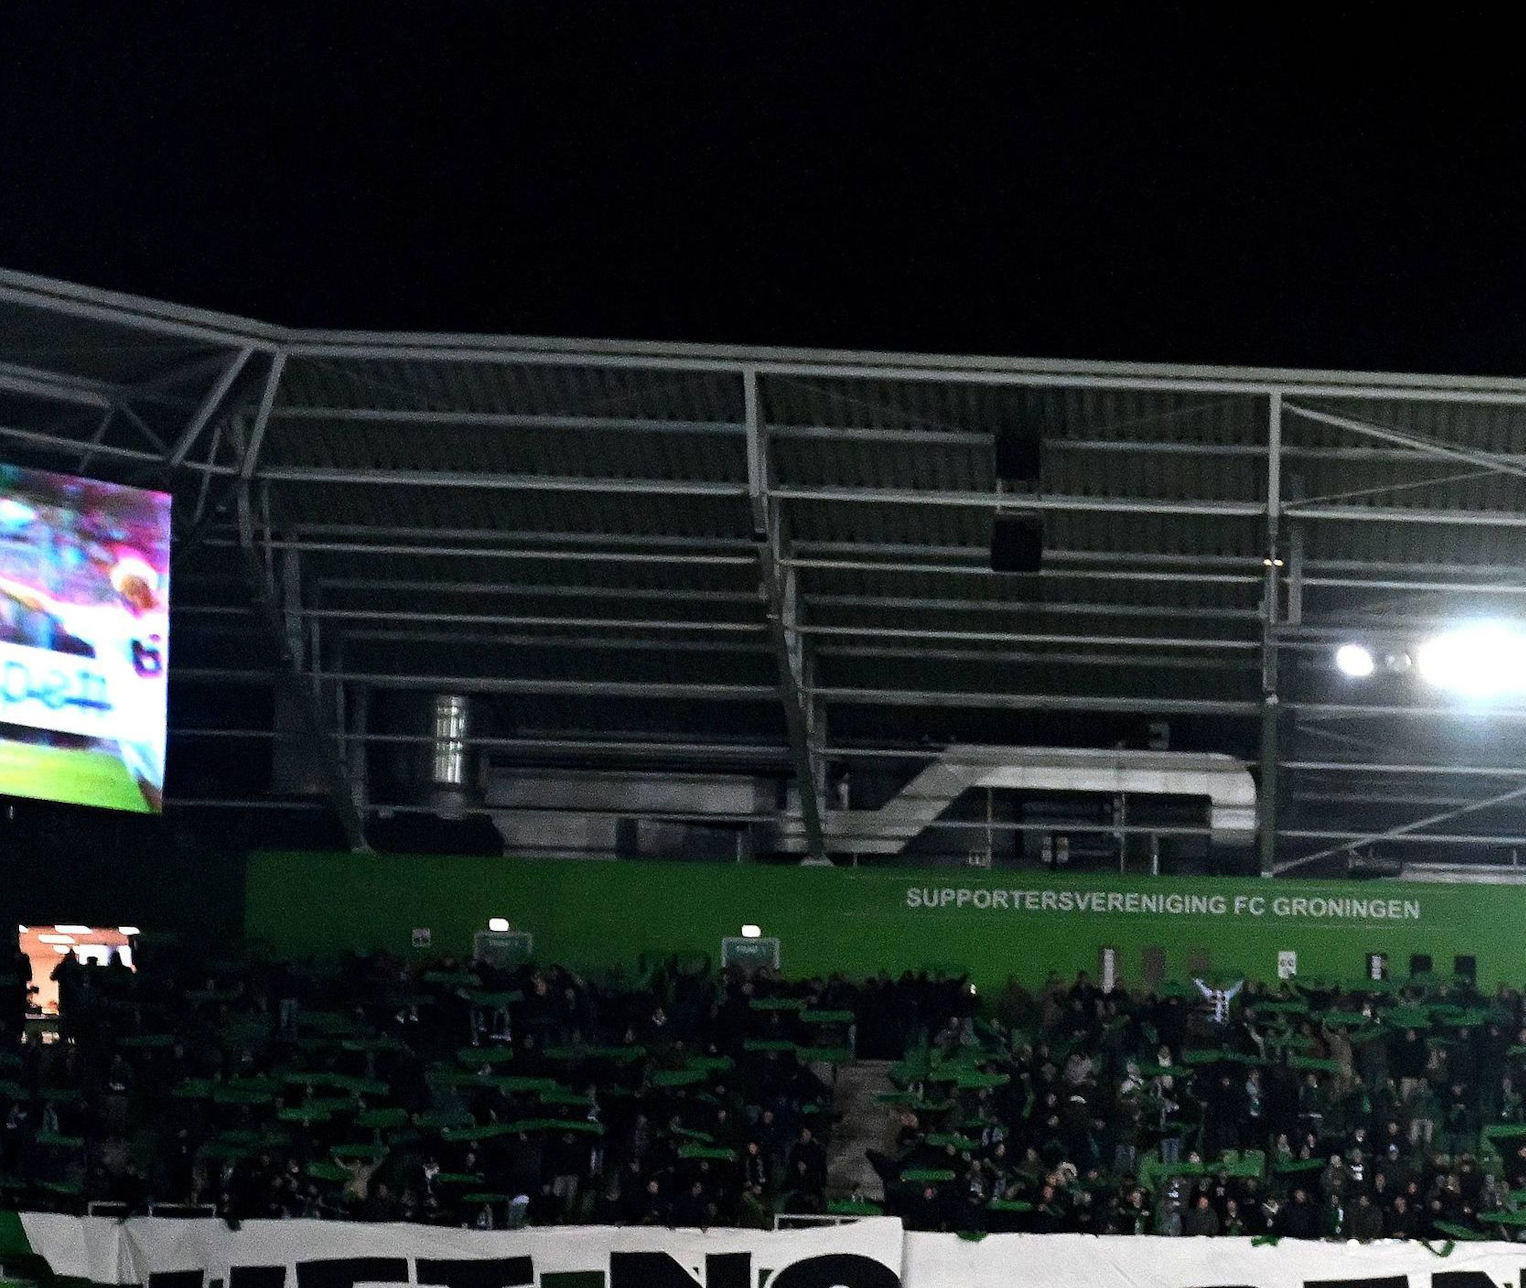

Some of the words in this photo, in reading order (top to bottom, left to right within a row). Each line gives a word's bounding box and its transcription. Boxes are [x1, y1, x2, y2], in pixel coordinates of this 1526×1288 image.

[906, 887, 1227, 916] SUPPORTERSVERENIGING
[1234, 896, 1265, 917] FC
[1272, 896, 1421, 920] GRONINGEN
